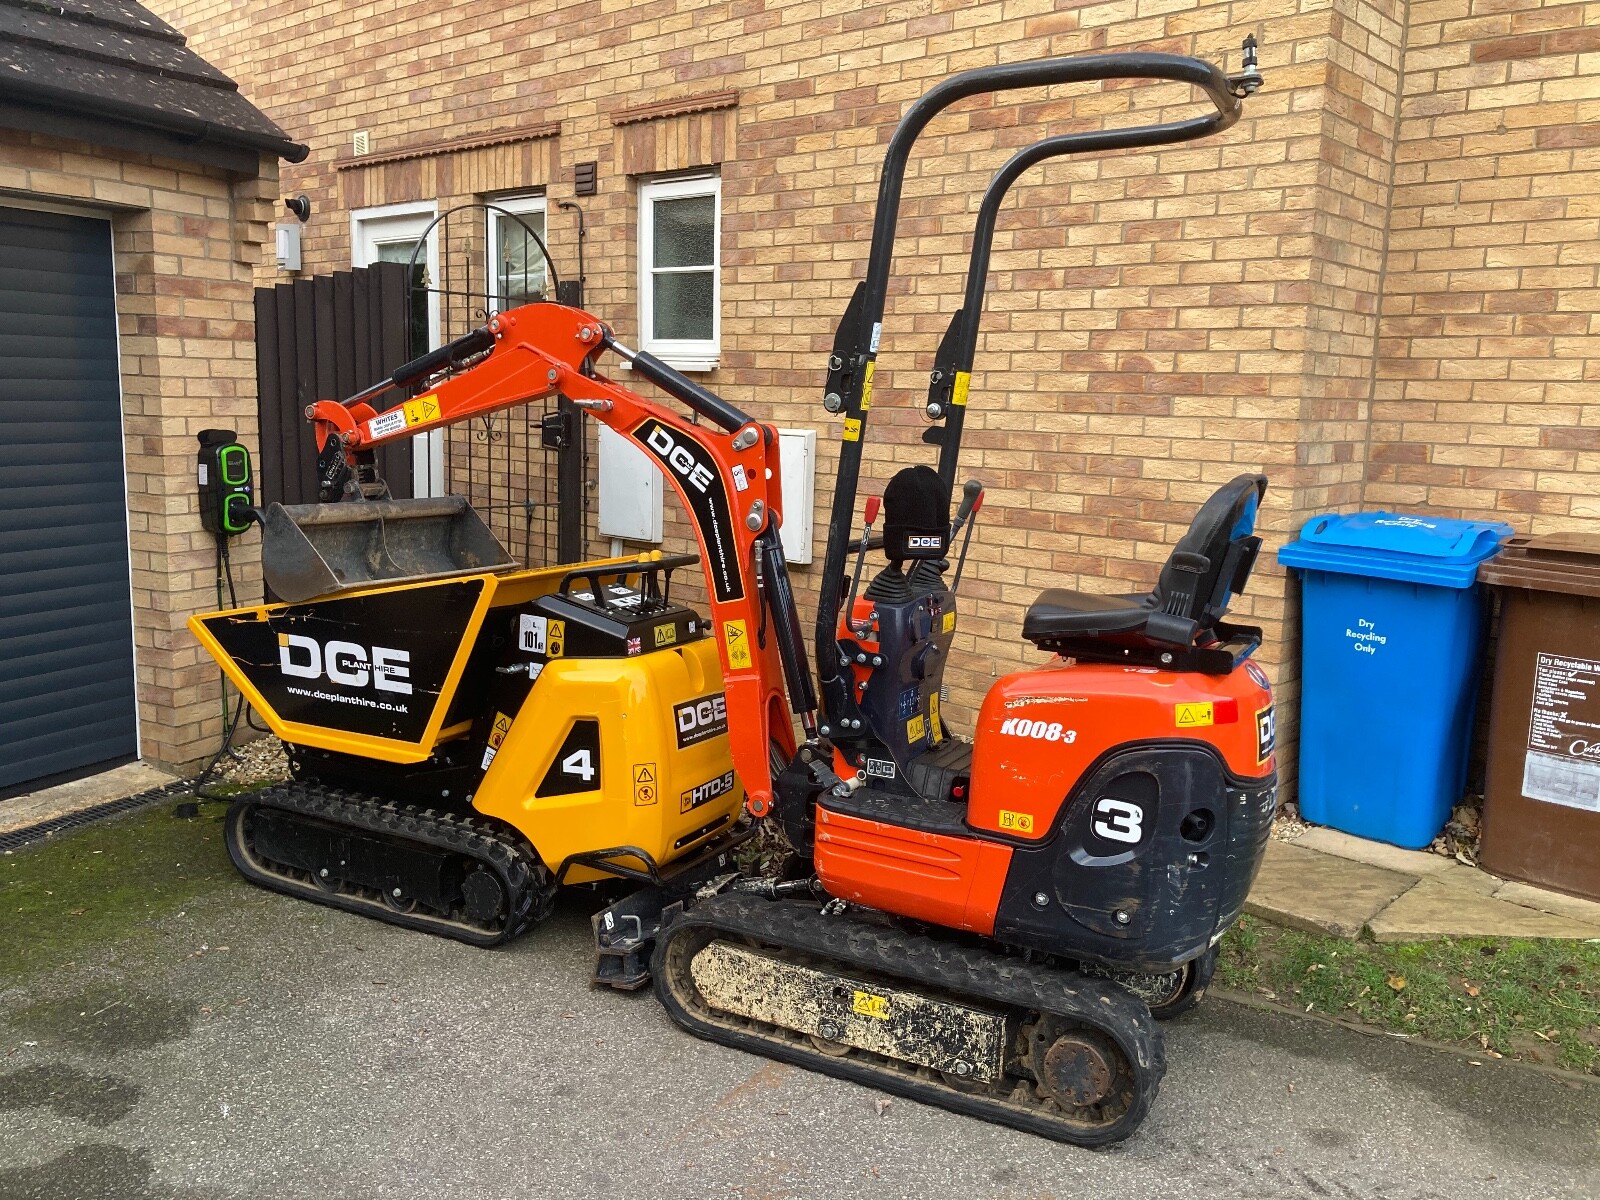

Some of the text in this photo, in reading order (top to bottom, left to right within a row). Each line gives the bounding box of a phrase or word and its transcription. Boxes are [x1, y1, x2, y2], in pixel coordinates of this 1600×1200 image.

[375, 414, 398, 426] WHITES
[646, 424, 715, 494] DCE
[708, 497, 731, 593] www.dceplanthire.co.uk
[910, 537, 940, 547] DCE
[1345, 628, 1387, 645] Recycling
[1358, 618, 1375, 631] Dry
[524, 630, 538, 649] 101
[1354, 642, 1376, 655] Only
[277, 632, 413, 695] DCE
[341, 659, 396, 674] PLANT HIRE
[1540, 656, 1553, 666] Dry
[1553, 658, 1593, 671] Recyclable
[286, 686, 409, 714] www.dceplanthire.co.uk
[677, 696, 727, 733] DCE
[1000, 717, 1077, 744] K008-3
[562, 749, 595, 781] 4
[692, 771, 733, 804] HTD-5
[1095, 798, 1144, 844] 3
